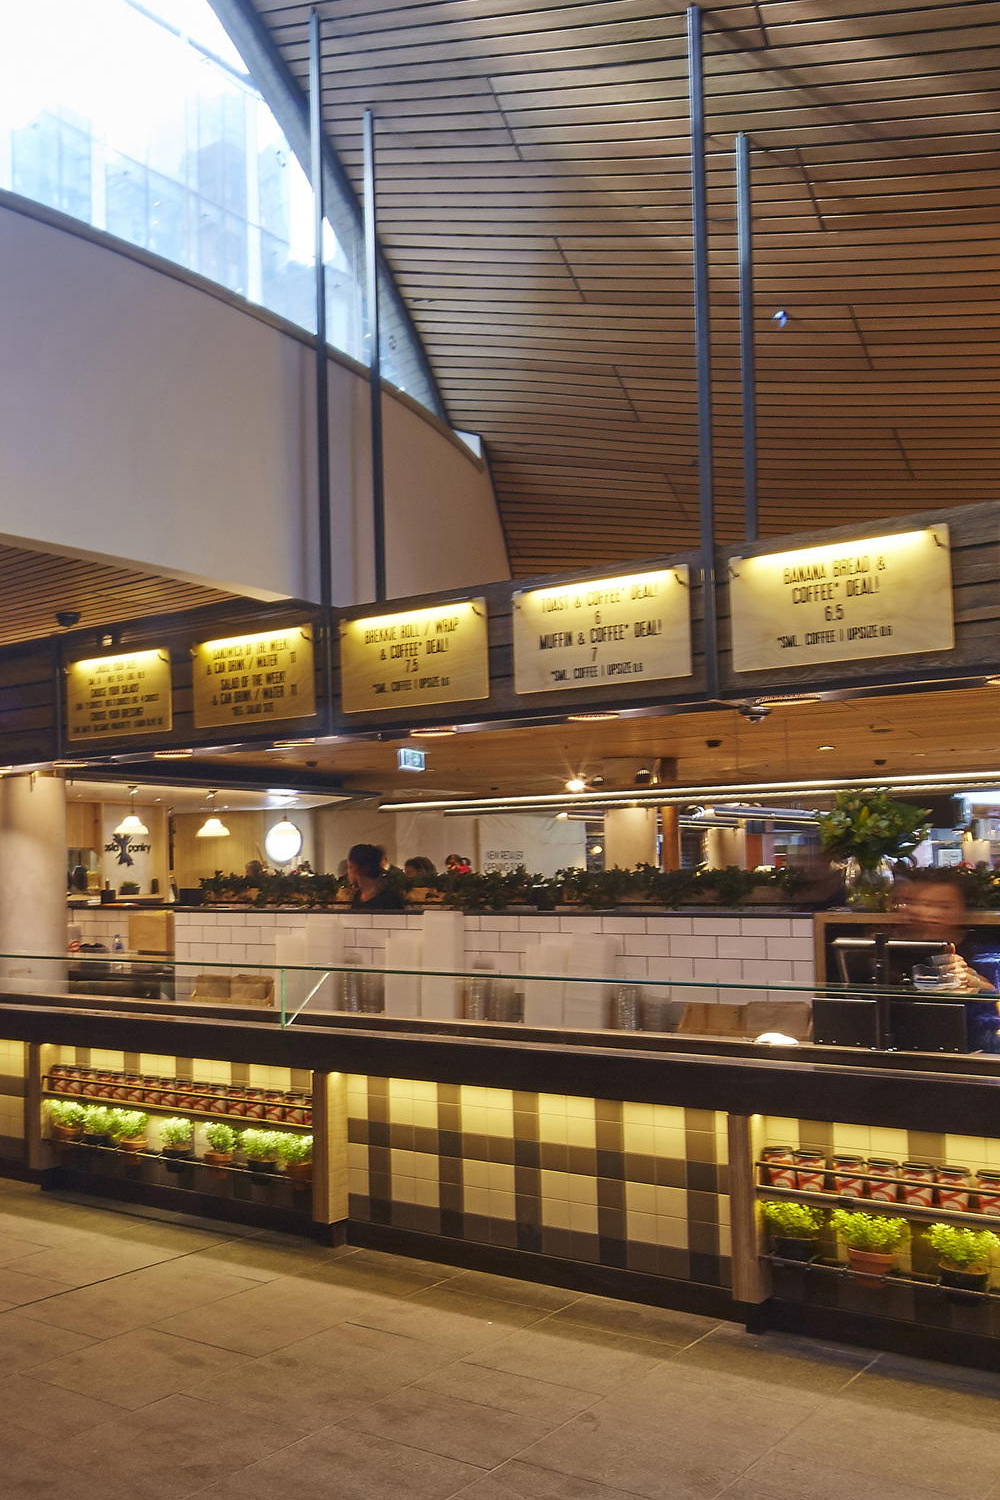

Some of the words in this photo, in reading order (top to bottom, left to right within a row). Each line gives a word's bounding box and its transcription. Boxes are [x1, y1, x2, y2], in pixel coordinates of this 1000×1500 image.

[784, 563, 826, 584] BANANA
[834, 556, 870, 577] BREAD
[877, 556, 887, 571] &
[846, 576, 880, 597] DEAL!
[542, 595, 568, 613] TOAST
[631, 582, 659, 600] DEAL!
[595, 611, 601, 624] 6
[824, 604, 844, 621] 6.5
[539, 631, 574, 650] MUFFIN
[578, 632, 586, 645] &
[634, 619, 662, 638] DEAL!
[805, 630, 835, 645] COFFEE
[426, 637, 450, 654] DEAL!
[591, 647, 598, 661] 7
[573, 665, 598, 679] COFFEE
